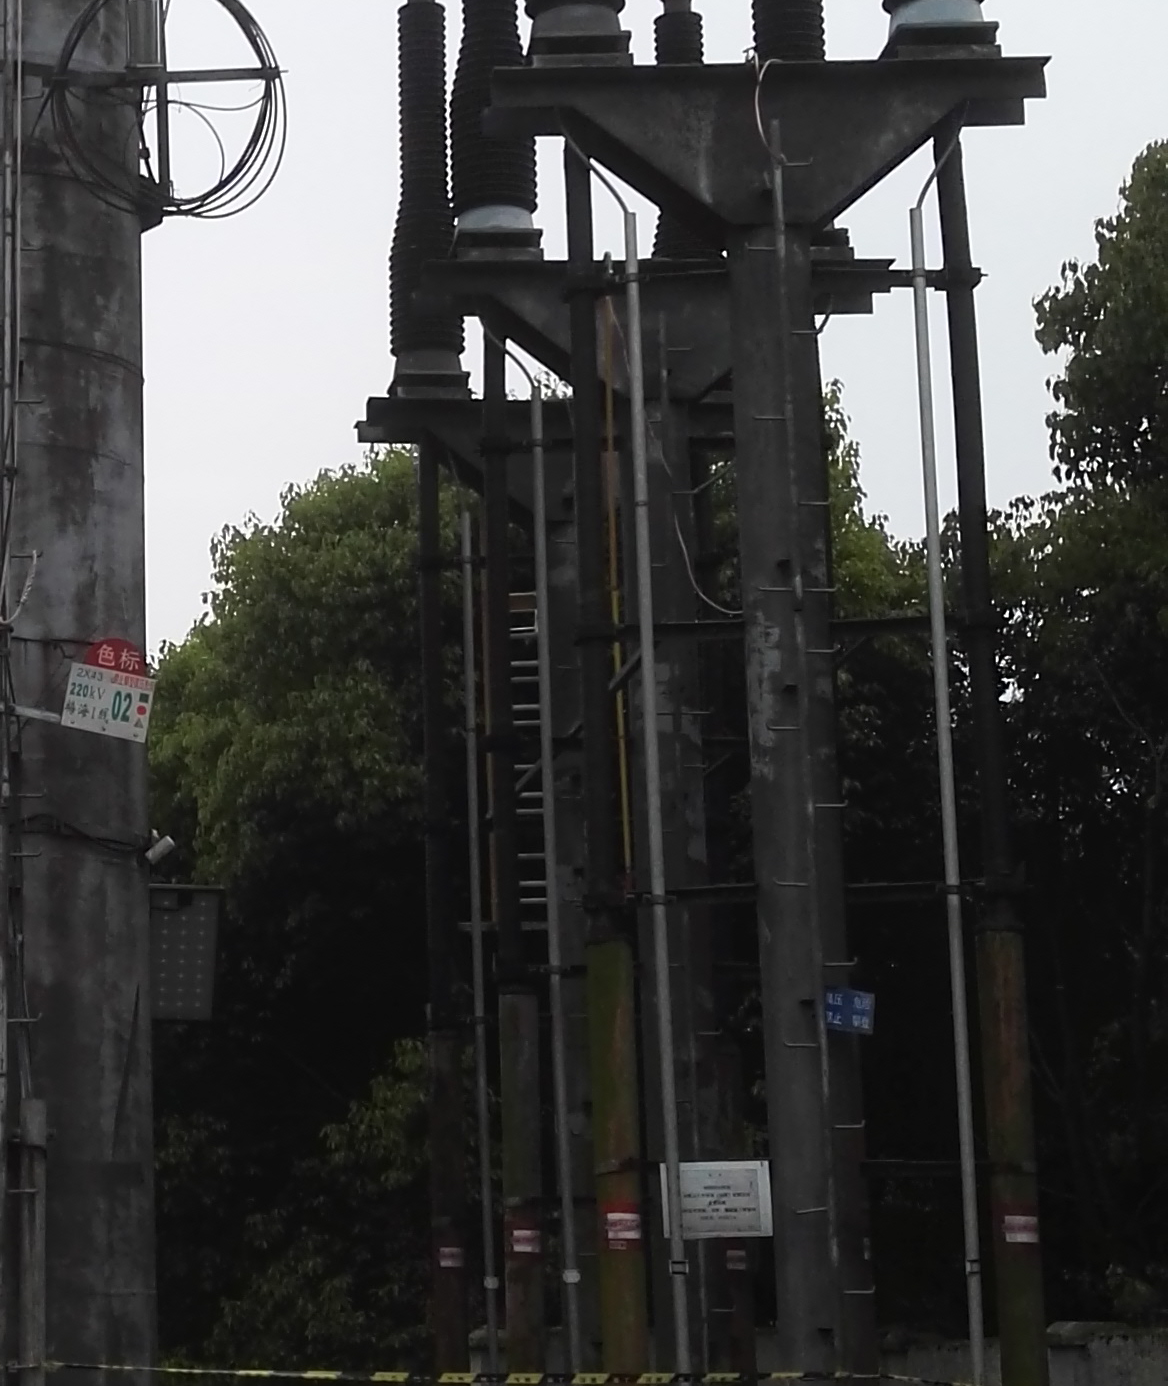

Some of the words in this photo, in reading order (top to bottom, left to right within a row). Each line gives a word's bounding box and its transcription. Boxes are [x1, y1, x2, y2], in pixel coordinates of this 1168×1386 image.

[97, 644, 140, 671] 色标
[70, 683, 105, 700] 220kV
[112, 691, 132, 722] 02
